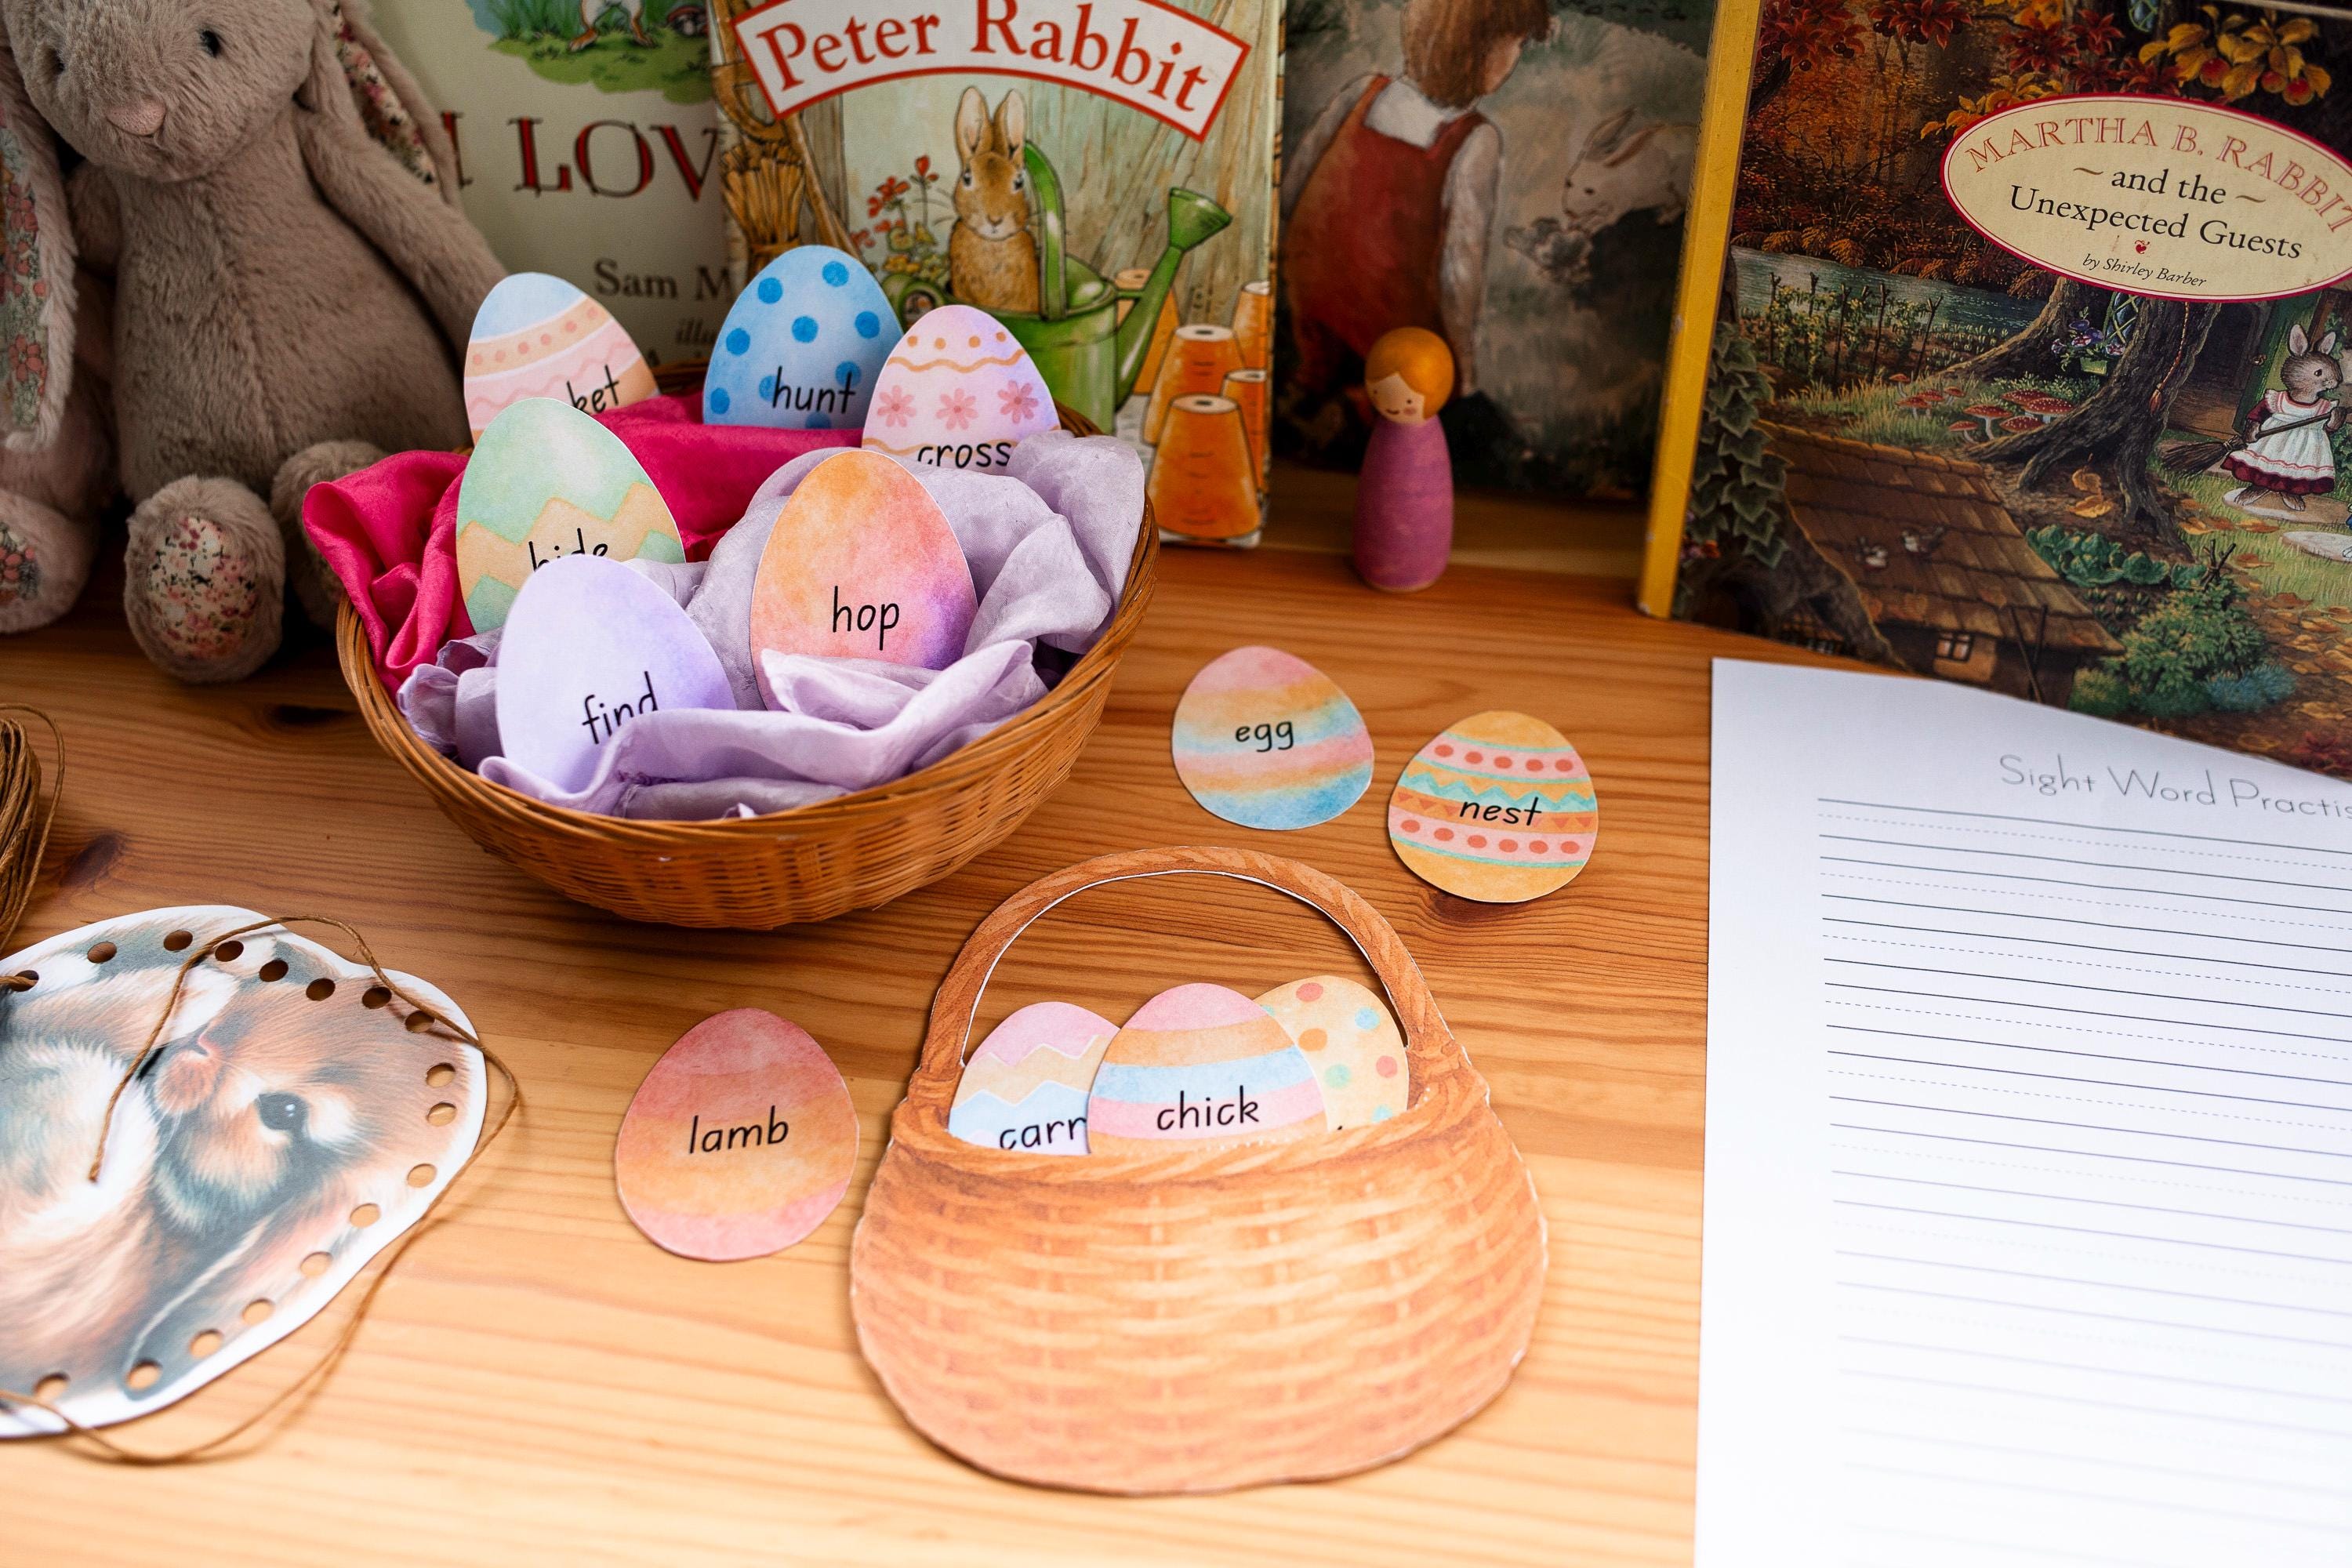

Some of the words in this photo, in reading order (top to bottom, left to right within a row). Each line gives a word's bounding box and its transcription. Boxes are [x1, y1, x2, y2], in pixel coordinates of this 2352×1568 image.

[756, 10, 940, 92] Peter
[971, 0, 1208, 112] Rabbit
[508, 118, 720, 203] LOV
[1964, 118, 2158, 173] MARTHA
[2170, 124, 2203, 157] B.
[2111, 168, 2170, 194] and
[2178, 174, 2227, 205] the
[2010, 184, 2188, 238] Unexpected
[2199, 219, 2303, 259] Guests
[593, 257, 678, 299] Sam
[2082, 253, 2100, 271] by
[2103, 258, 2154, 281] Shirley
[2156, 267, 2207, 288] Barber
[771, 365, 857, 414] hunt
[916, 441, 1012, 469] cross
[832, 586, 900, 651] hop
[582, 670, 659, 745] find
[1235, 720, 1295, 753] egg
[2000, 753, 2096, 797] Sight
[2107, 766, 2216, 806] Word
[1459, 797, 1543, 827] nest
[689, 1105, 789, 1155] lamb
[1156, 1085, 1261, 1131] chick
[1000, 1116, 1087, 1150] carr
